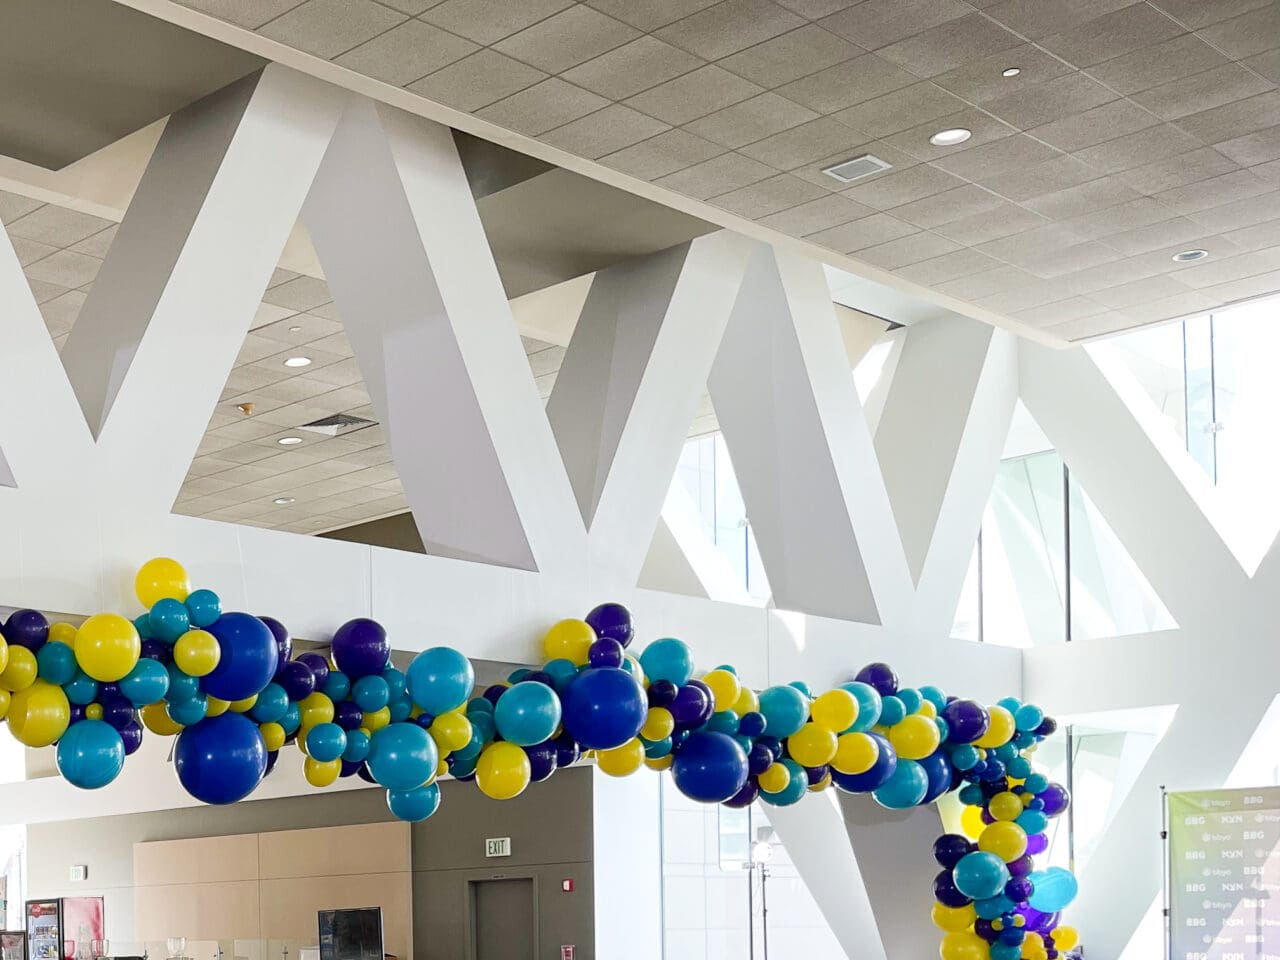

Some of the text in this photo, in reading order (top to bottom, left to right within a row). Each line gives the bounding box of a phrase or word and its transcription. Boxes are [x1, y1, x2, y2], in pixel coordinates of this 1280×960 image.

[1243, 831, 1264, 840] BBG
[488, 840, 505, 855] EXIT
[1185, 884, 1206, 893] BBG
